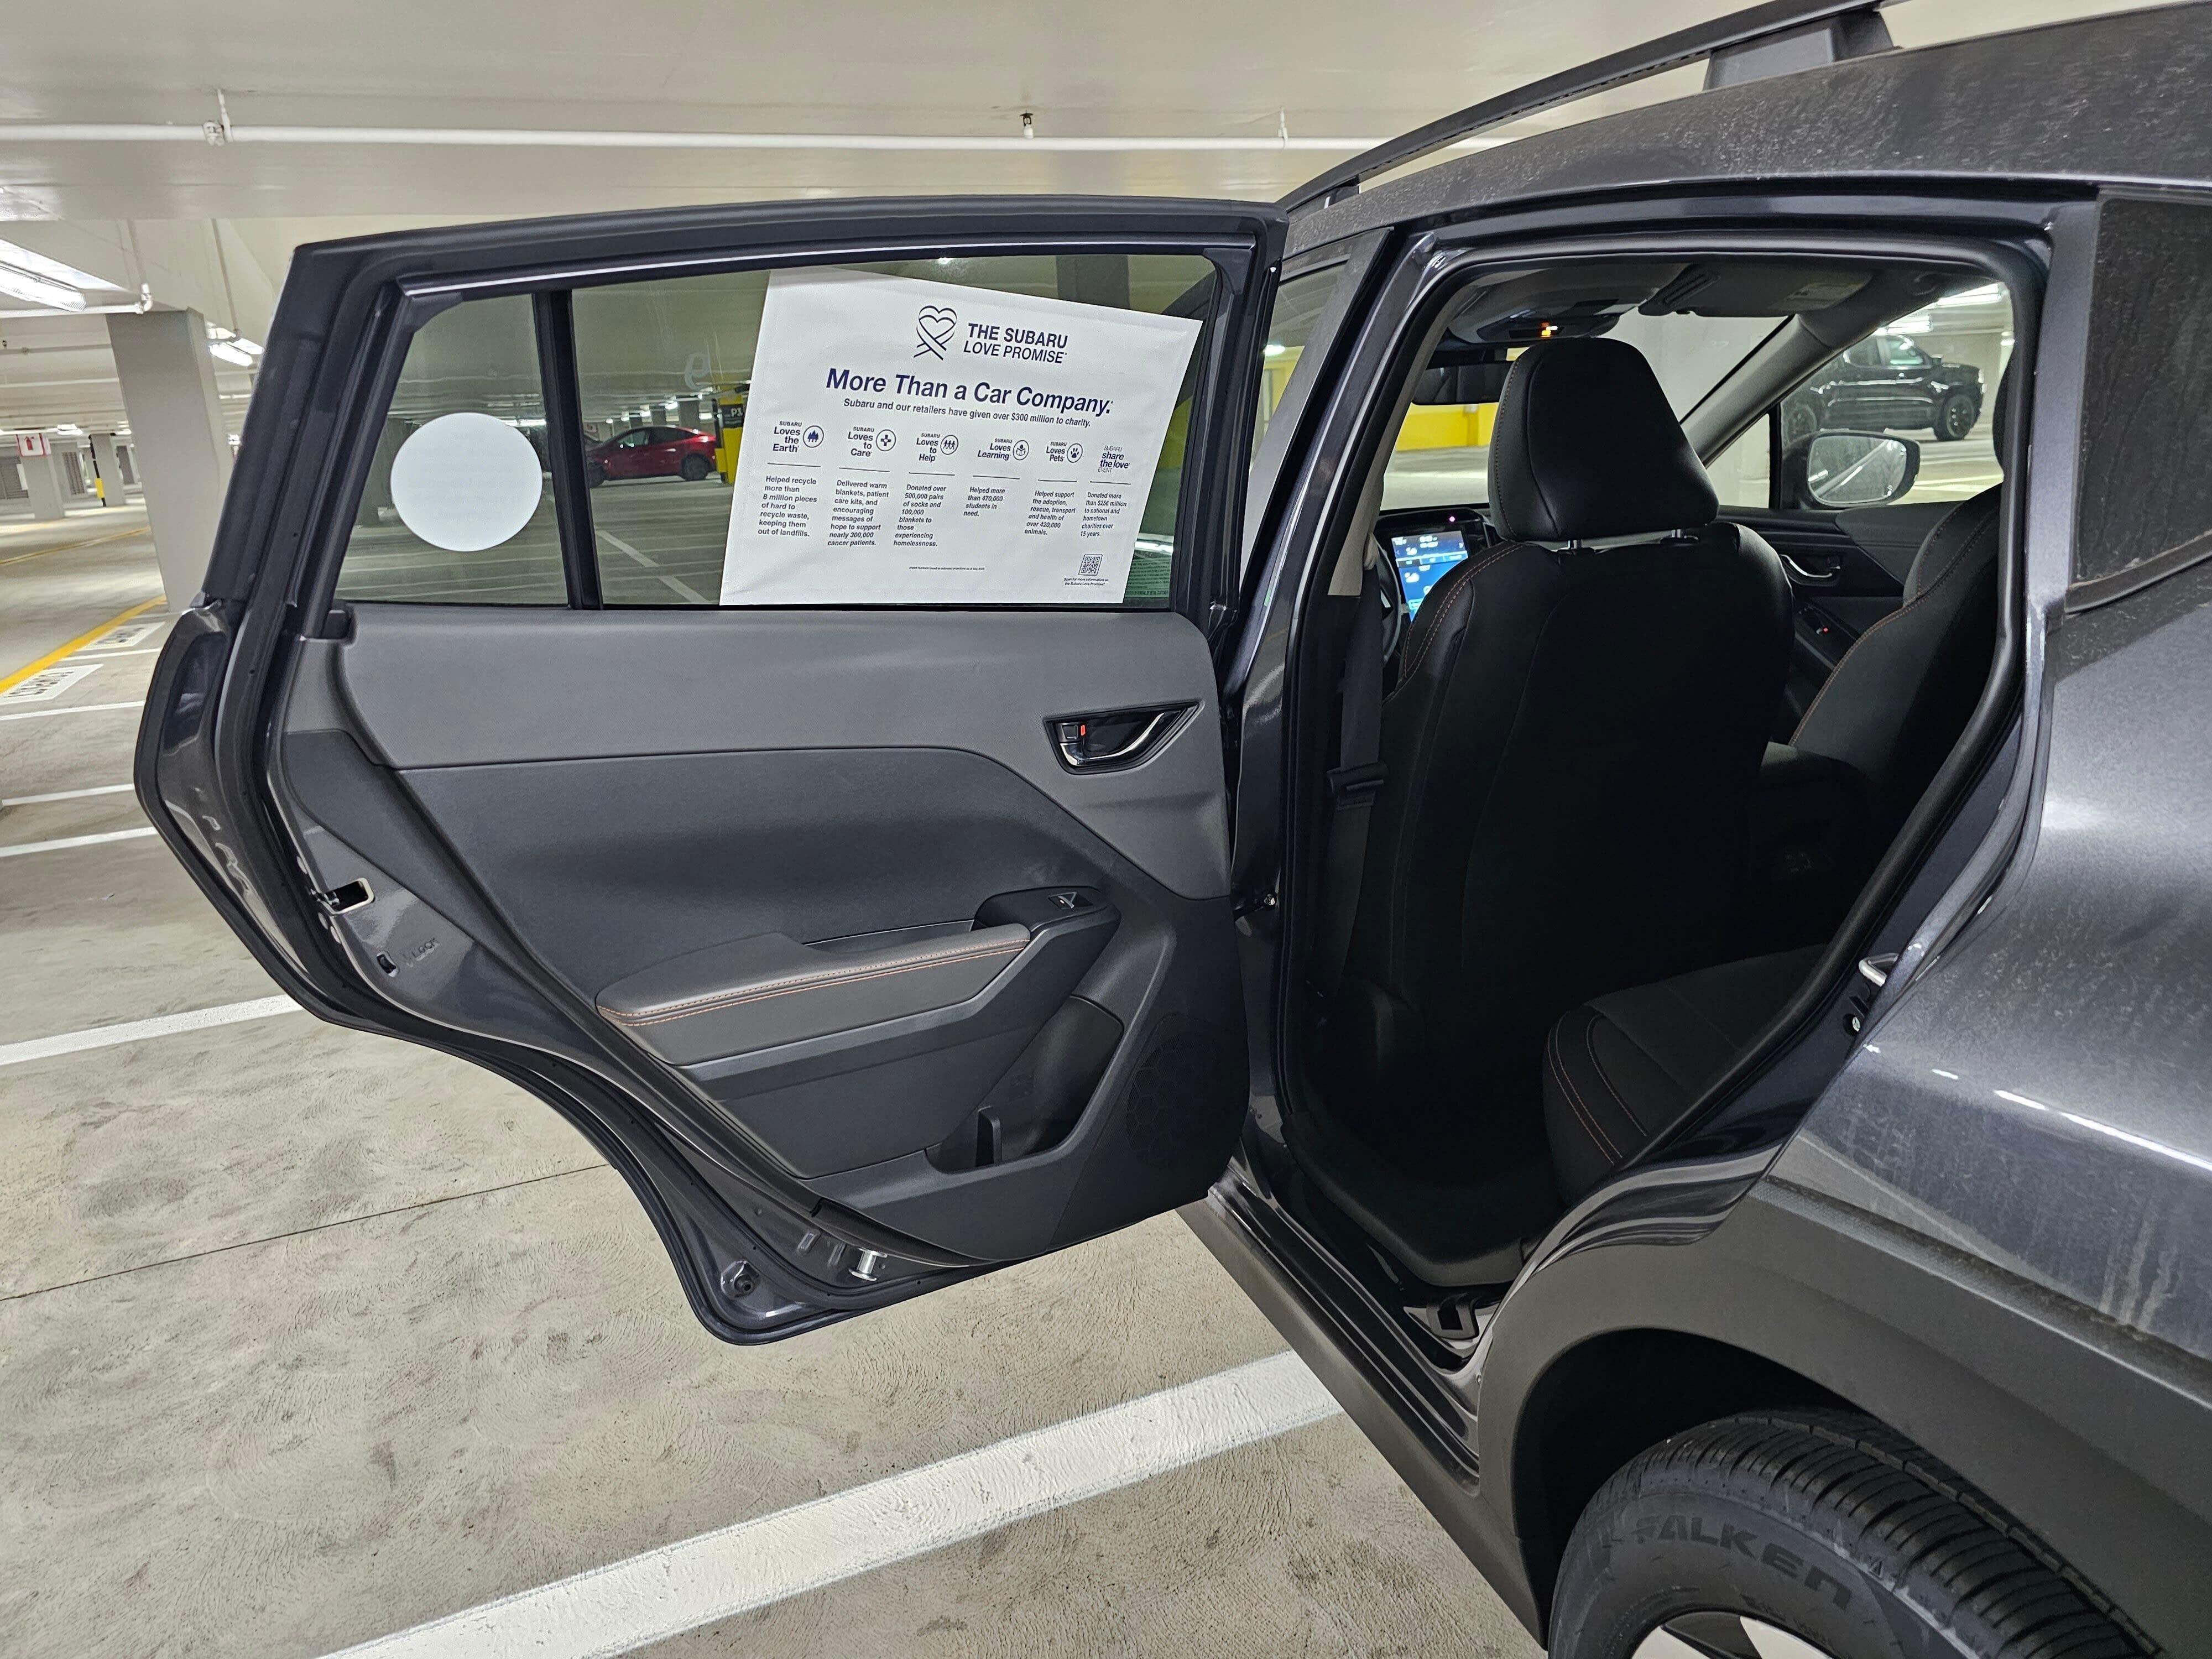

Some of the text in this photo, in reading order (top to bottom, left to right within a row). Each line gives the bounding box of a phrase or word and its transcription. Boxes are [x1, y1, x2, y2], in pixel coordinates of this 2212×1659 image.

[968, 322, 1068, 348] THE SUBARU
[963, 341, 1001, 356] LOVE
[826, 368, 886, 392] More
[895, 374, 947, 398] Than
[954, 385, 967, 400] a
[974, 382, 1012, 404] Car
[844, 398, 875, 408] Subaru
[877, 401, 894, 410] and
[913, 405, 946, 415] retailers
[948, 407, 967, 416] have
[969, 409, 990, 419] given
[1011, 413, 1028, 421] $300
[1030, 414, 1054, 424] million
[1065, 418, 1090, 428] charity.
[774, 426, 800, 436] Loves
[785, 436, 799, 444] the
[848, 431, 873, 441] Loves
[916, 437, 938, 446] Loves
[773, 444, 797, 452] Earth
[990, 442, 1011, 451] Loves
[1046, 446, 1065, 454] Loves
[851, 448, 872, 457] Care
[978, 450, 1011, 461] Learning
[1102, 451, 1124, 461] share
[919, 453, 937, 463] Help
[1113, 460, 1129, 468] love
[766, 476, 790, 484] Helped
[836, 489, 865, 497] blankets,
[759, 519, 786, 528] keeping
[1629, 1515, 1852, 1610] FALKEN
